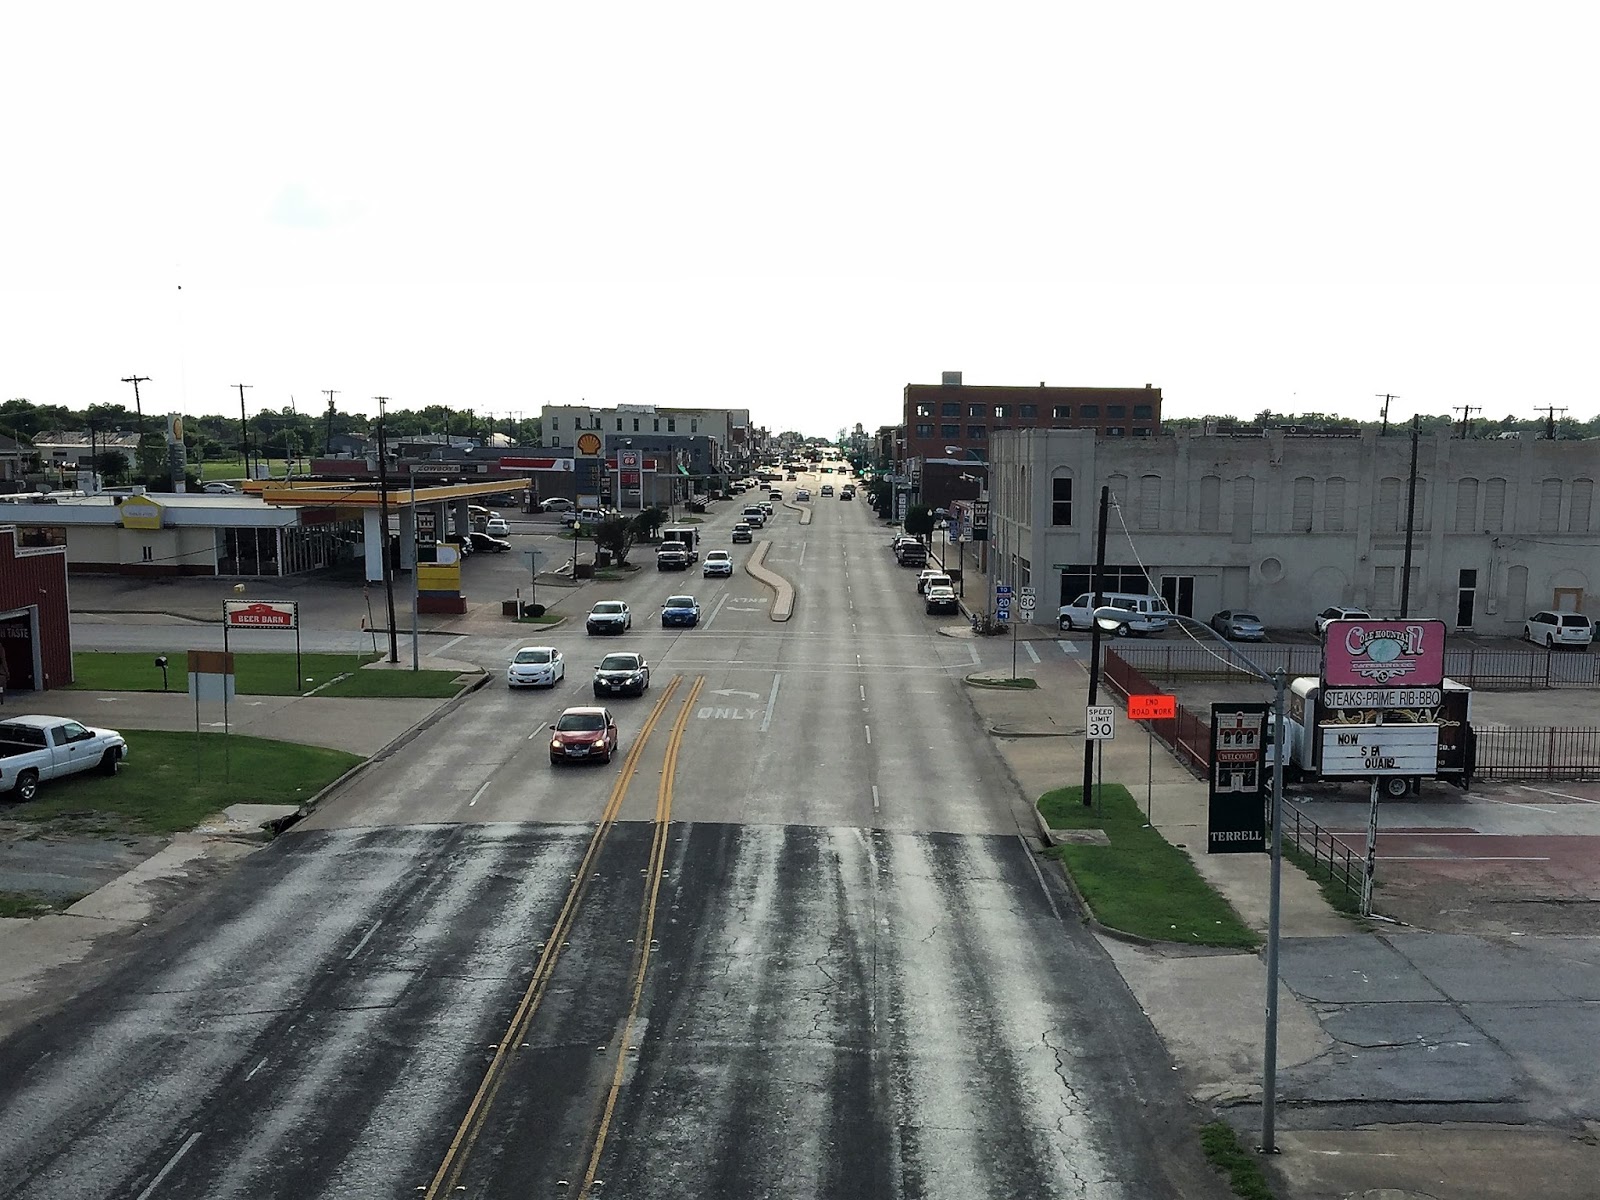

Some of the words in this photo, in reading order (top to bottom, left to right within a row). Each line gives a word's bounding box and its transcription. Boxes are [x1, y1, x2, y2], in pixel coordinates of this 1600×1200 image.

[998, 598, 1009, 607] 20
[1021, 598, 1035, 607] 80
[238, 615, 260, 623] BEER
[7, 628, 29, 639] TASTE
[1145, 698, 1159, 706] END
[1325, 691, 1396, 707] STEAKS-PRIME
[1400, 690, 1440, 706] RIB-BBQ
[697, 707, 760, 720] ONLY
[1132, 708, 1150, 716] ROAD
[1089, 723, 1112, 736] 30
[1337, 733, 1359, 745] NOW
[1221, 752, 1254, 761] WELCOME
[1210, 830, 1263, 842] TERRELL
